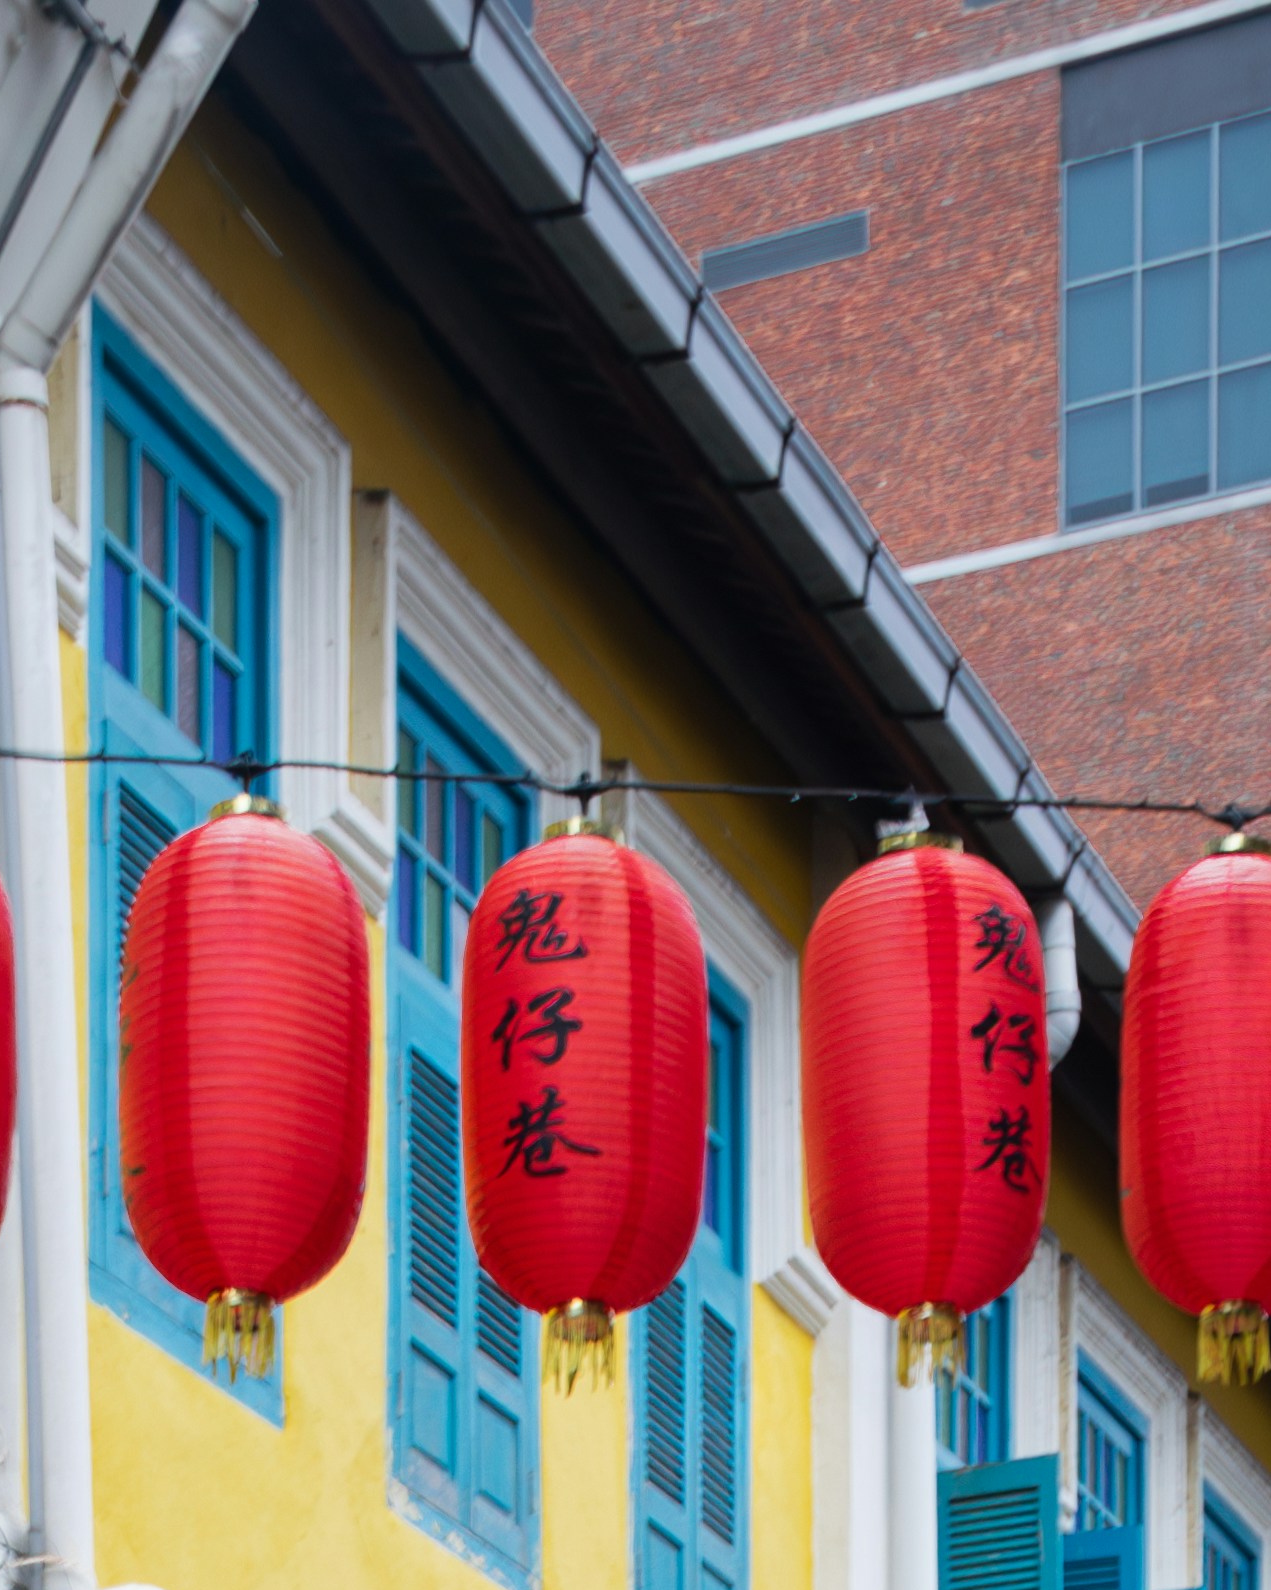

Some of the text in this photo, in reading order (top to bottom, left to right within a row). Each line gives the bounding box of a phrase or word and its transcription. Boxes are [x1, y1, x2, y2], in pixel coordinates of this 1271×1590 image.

[491, 889, 601, 1180] 鬼仔巷
[972, 904, 1045, 1196] 鬼仔巷
